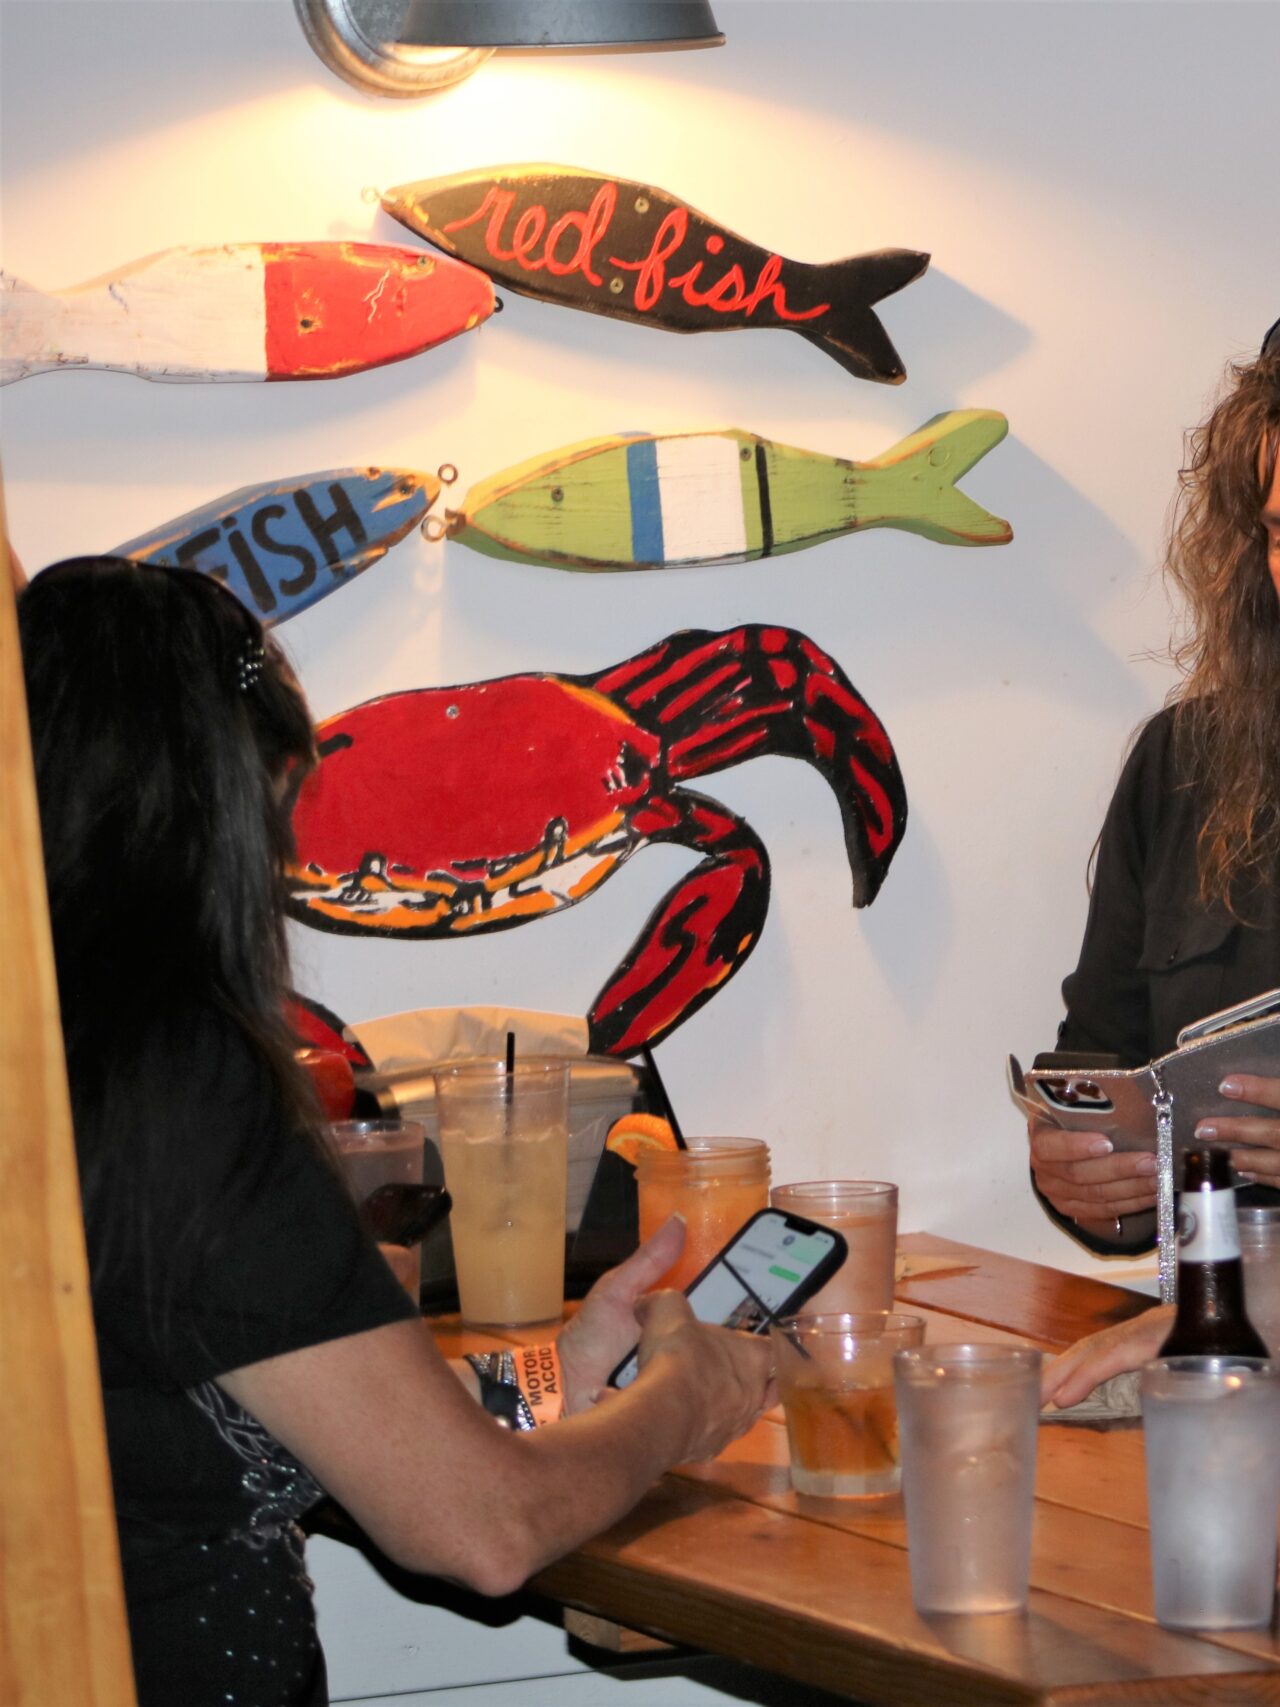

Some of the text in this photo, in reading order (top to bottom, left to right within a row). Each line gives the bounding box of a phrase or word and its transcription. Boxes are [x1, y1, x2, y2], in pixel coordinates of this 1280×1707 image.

[444, 181, 830, 321] red fish
[522, 1347, 543, 1407] MOTOR
